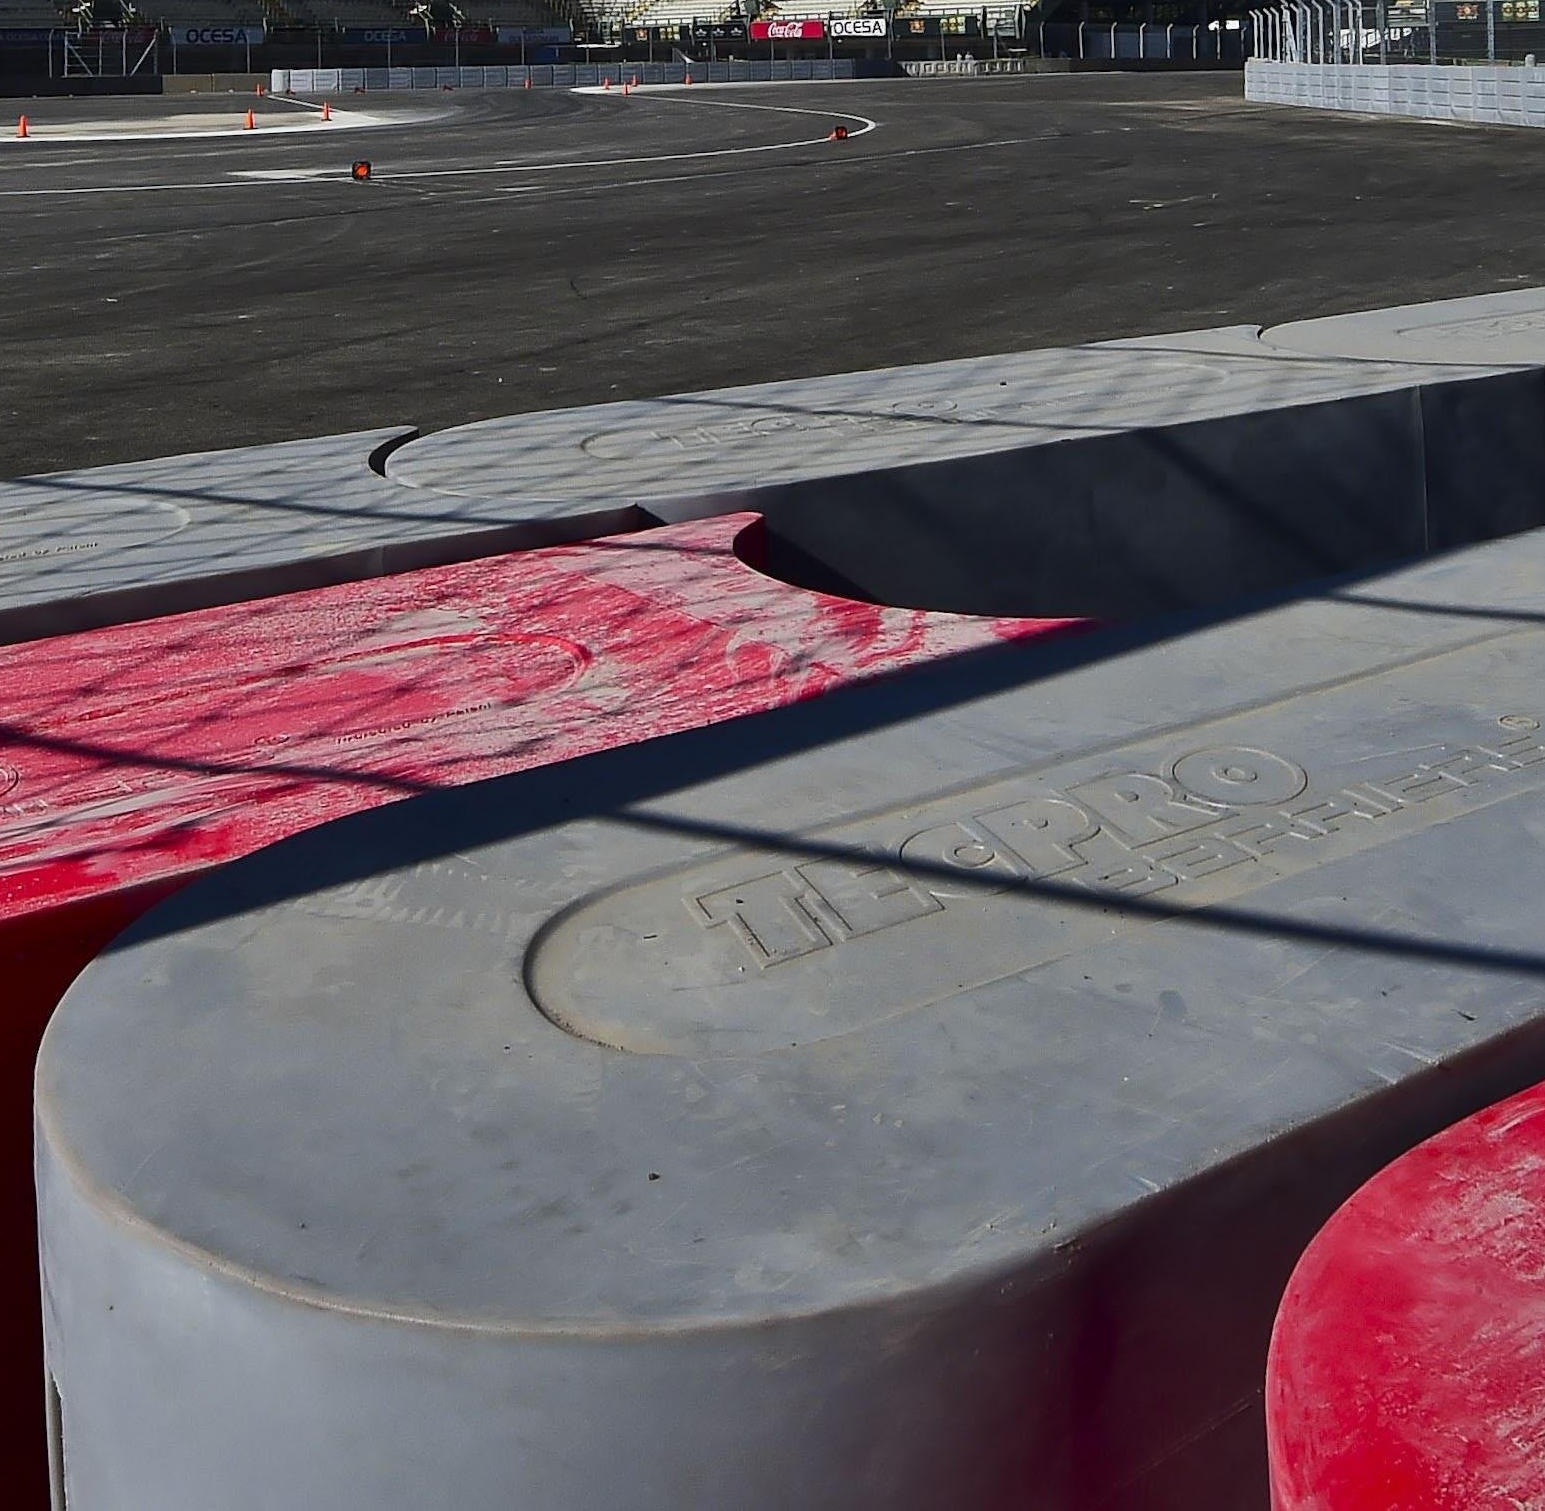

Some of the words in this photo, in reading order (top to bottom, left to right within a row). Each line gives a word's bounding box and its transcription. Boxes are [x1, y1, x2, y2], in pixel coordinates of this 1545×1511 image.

[363, 30, 407, 42] OCESA
[767, 22, 804, 38] Coca-Cola
[832, 20, 884, 36] OCESA
[186, 30, 247, 44] OCESA
[681, 744, 1310, 969] TECPRO
